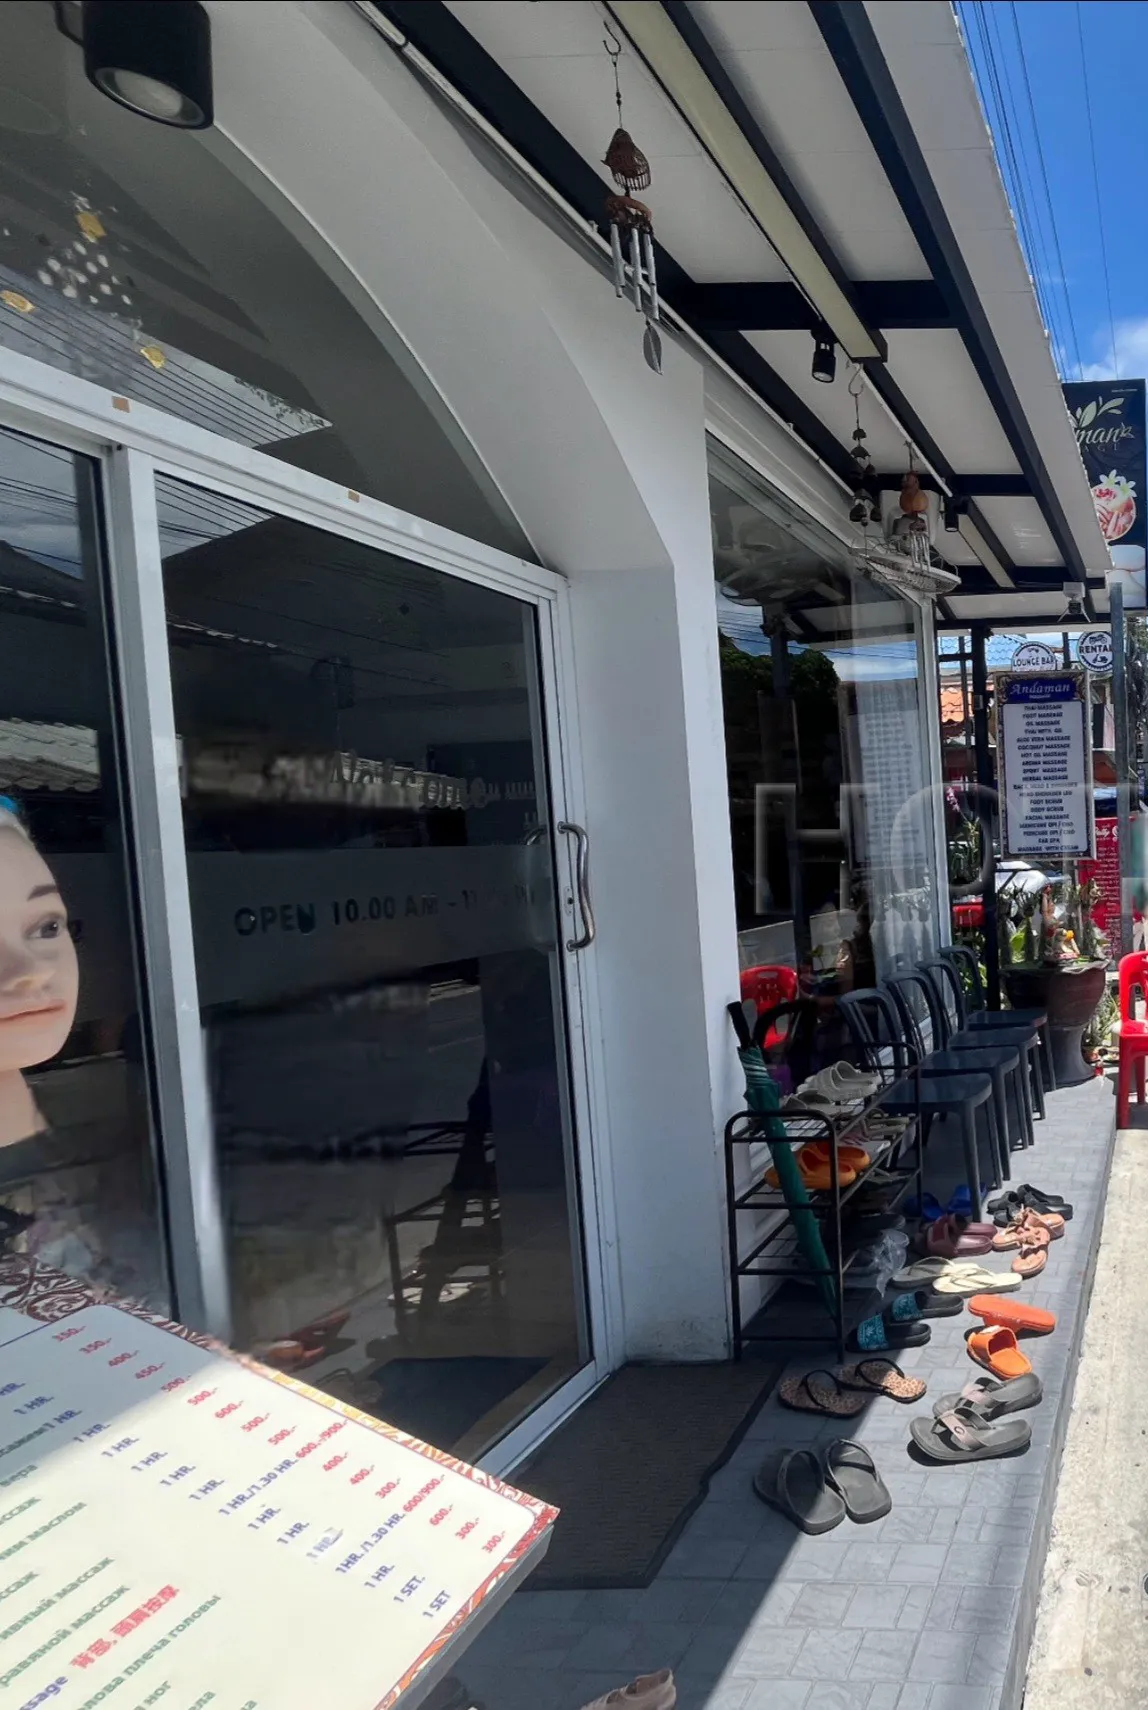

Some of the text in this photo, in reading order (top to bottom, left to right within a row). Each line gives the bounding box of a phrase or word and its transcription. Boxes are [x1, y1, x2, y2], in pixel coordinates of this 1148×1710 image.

[1010, 681, 1070, 694] Andaman
[234, 903, 316, 936] OPEN
[333, 896, 396, 925] 10.00
[405, 893, 439, 918] AM
[54, 1557, 115, 1599] массаж
[69, 1585, 131, 1630] массаж
[123, 1637, 172, 1677] плеча
[168, 1594, 222, 1639] головы
